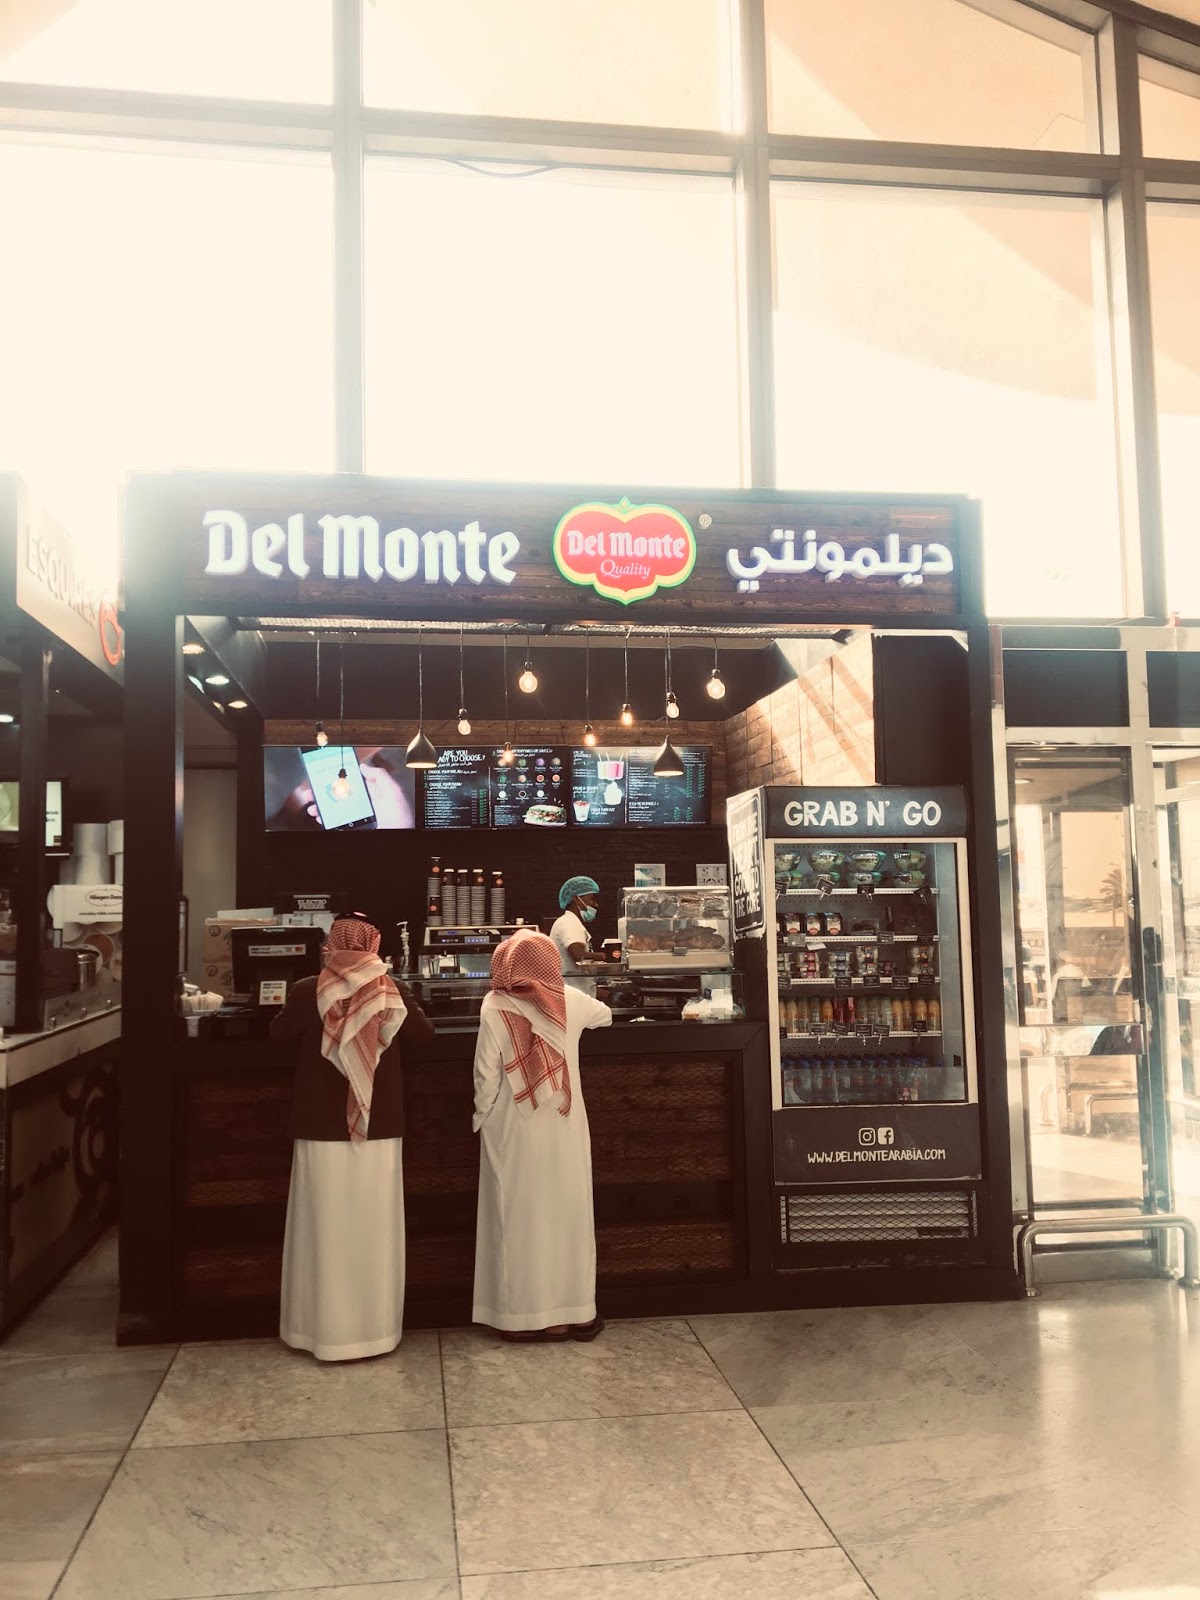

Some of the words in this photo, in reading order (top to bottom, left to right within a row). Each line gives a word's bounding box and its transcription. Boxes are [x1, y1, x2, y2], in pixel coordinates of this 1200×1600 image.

[202, 510, 310, 581] Del
[317, 514, 520, 587] Monte
[566, 530, 606, 557] Del
[608, 531, 686, 559] Monte
[600, 559, 651, 580] Quality
[725, 528, 954, 594] ديلمونتي
[784, 800, 859, 827] GRAB
[902, 800, 943, 826] GO
[735, 896, 746, 919] THE
